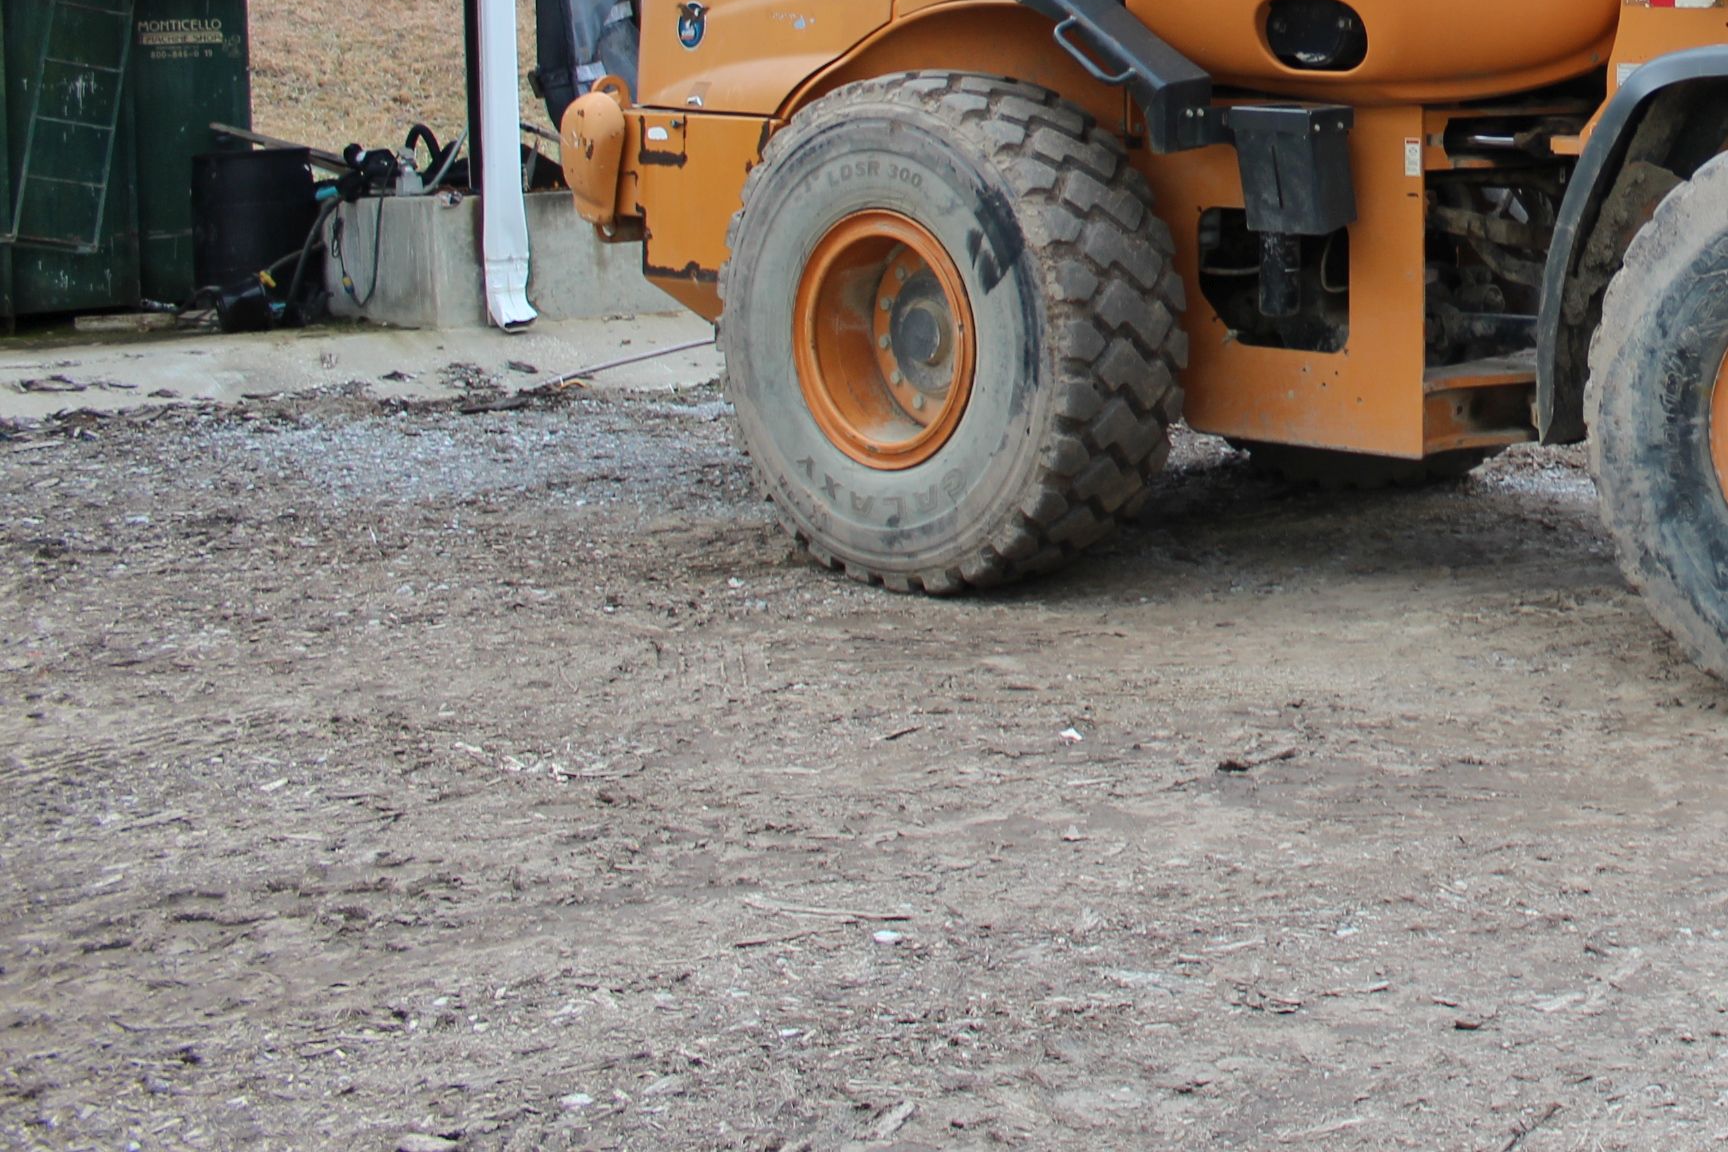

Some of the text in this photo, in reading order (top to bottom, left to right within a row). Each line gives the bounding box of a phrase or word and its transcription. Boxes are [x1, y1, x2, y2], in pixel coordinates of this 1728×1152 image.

[137, 18, 222, 32] MONTICELLO
[827, 160, 881, 186] LDSR
[887, 163, 924, 189] 300
[796, 454, 967, 517] GALAXY
